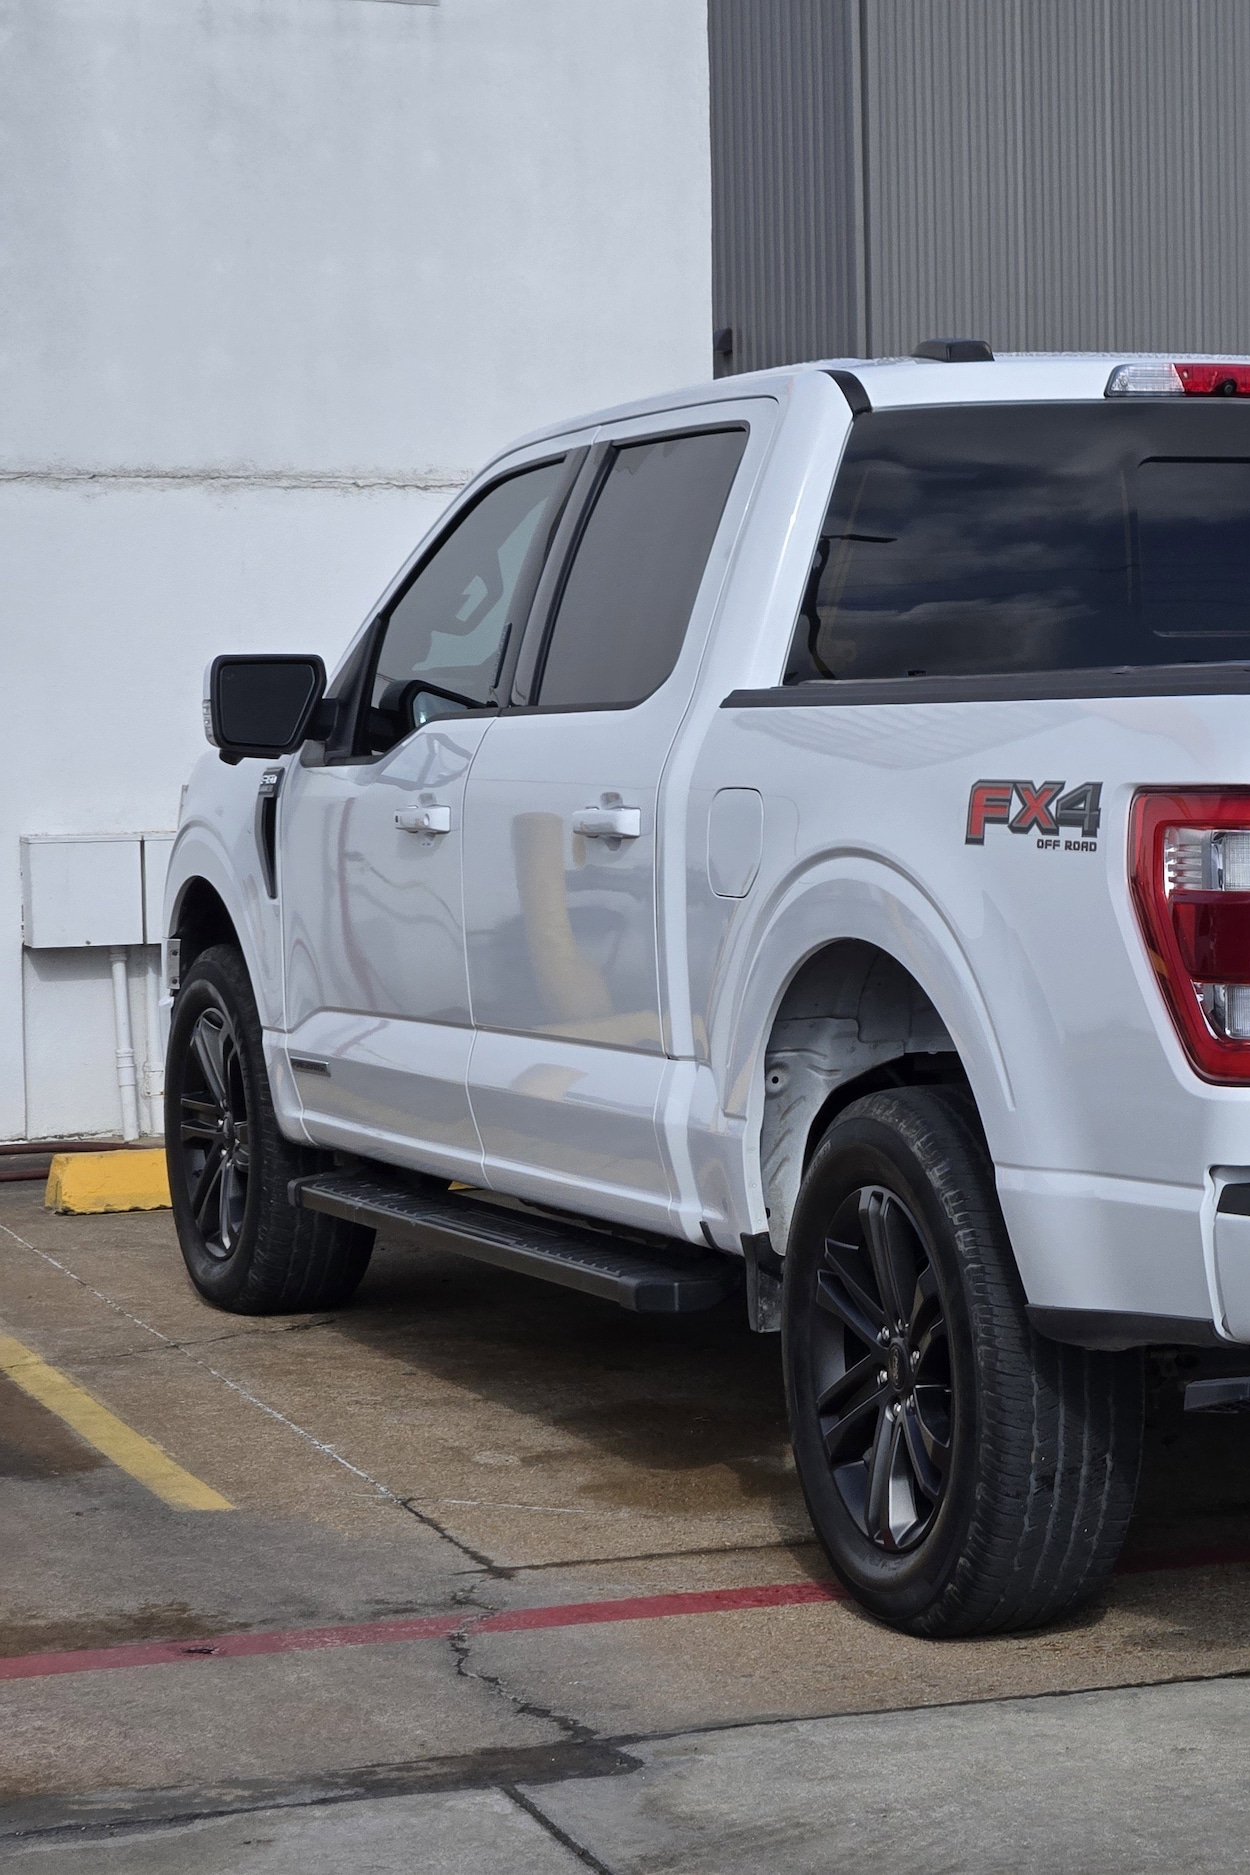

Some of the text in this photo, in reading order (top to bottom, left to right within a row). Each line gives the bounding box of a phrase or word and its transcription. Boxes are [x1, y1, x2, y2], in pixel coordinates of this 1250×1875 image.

[965, 779, 1103, 846] FX4
[1037, 839, 1097, 852] OFF ROAD
